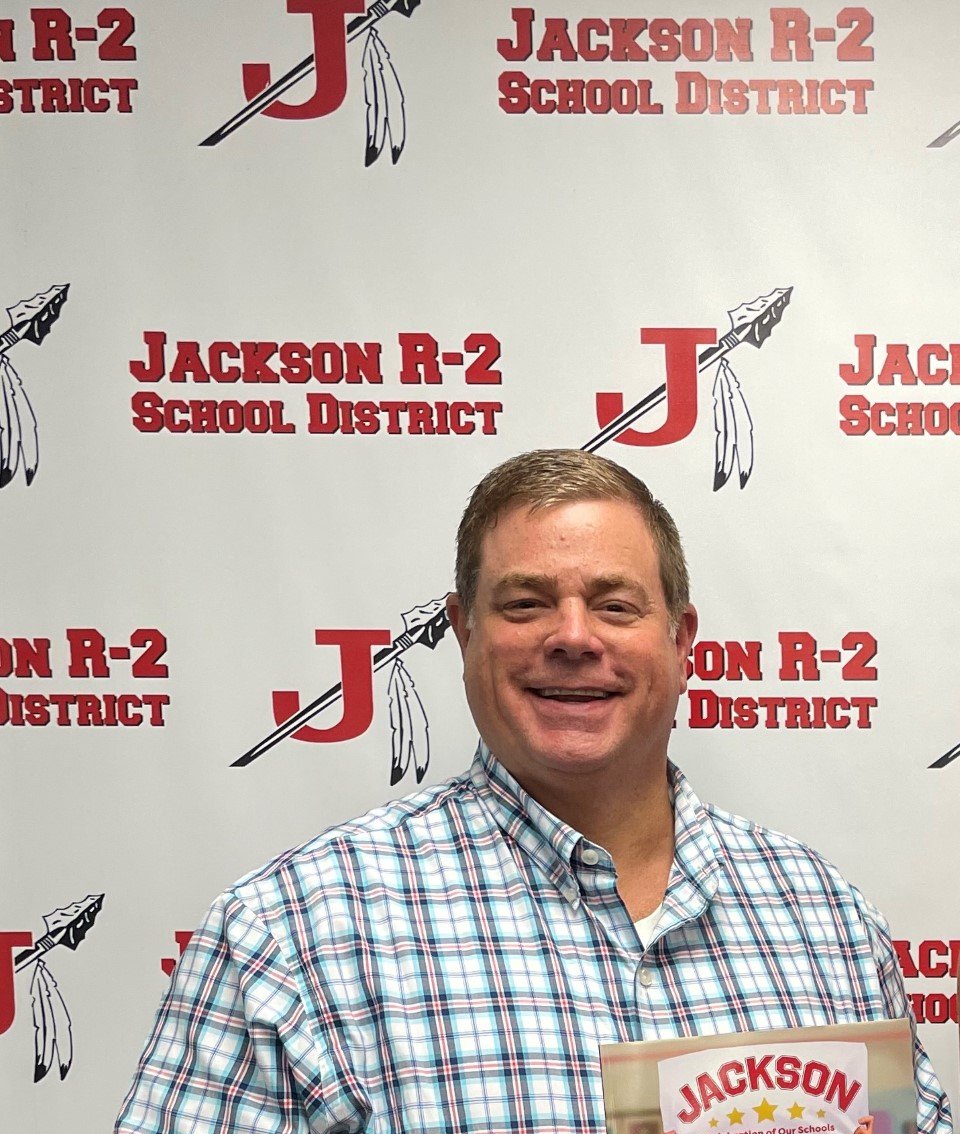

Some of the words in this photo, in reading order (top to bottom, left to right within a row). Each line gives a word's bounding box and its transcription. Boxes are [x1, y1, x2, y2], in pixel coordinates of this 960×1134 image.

[30, 7, 136, 61] R-2
[496, 7, 753, 61] JACKSON
[770, 7, 873, 61] R-2
[0, 77, 138, 113] STRICT
[498, 70, 663, 114] SCHOOL
[675, 71, 873, 114] DISTRICT
[129, 331, 383, 384] JACKSON
[398, 332, 502, 385] R-2
[131, 390, 295, 433] SCHOOL
[306, 392, 503, 435] DISTRICT
[66, 628, 168, 678] R-2
[777, 631, 877, 681] R-2
[688, 690, 878, 729] DISTRICT
[677, 1055, 862, 1124] JACKSON
[797, 1123, 835, 1134] Schools
